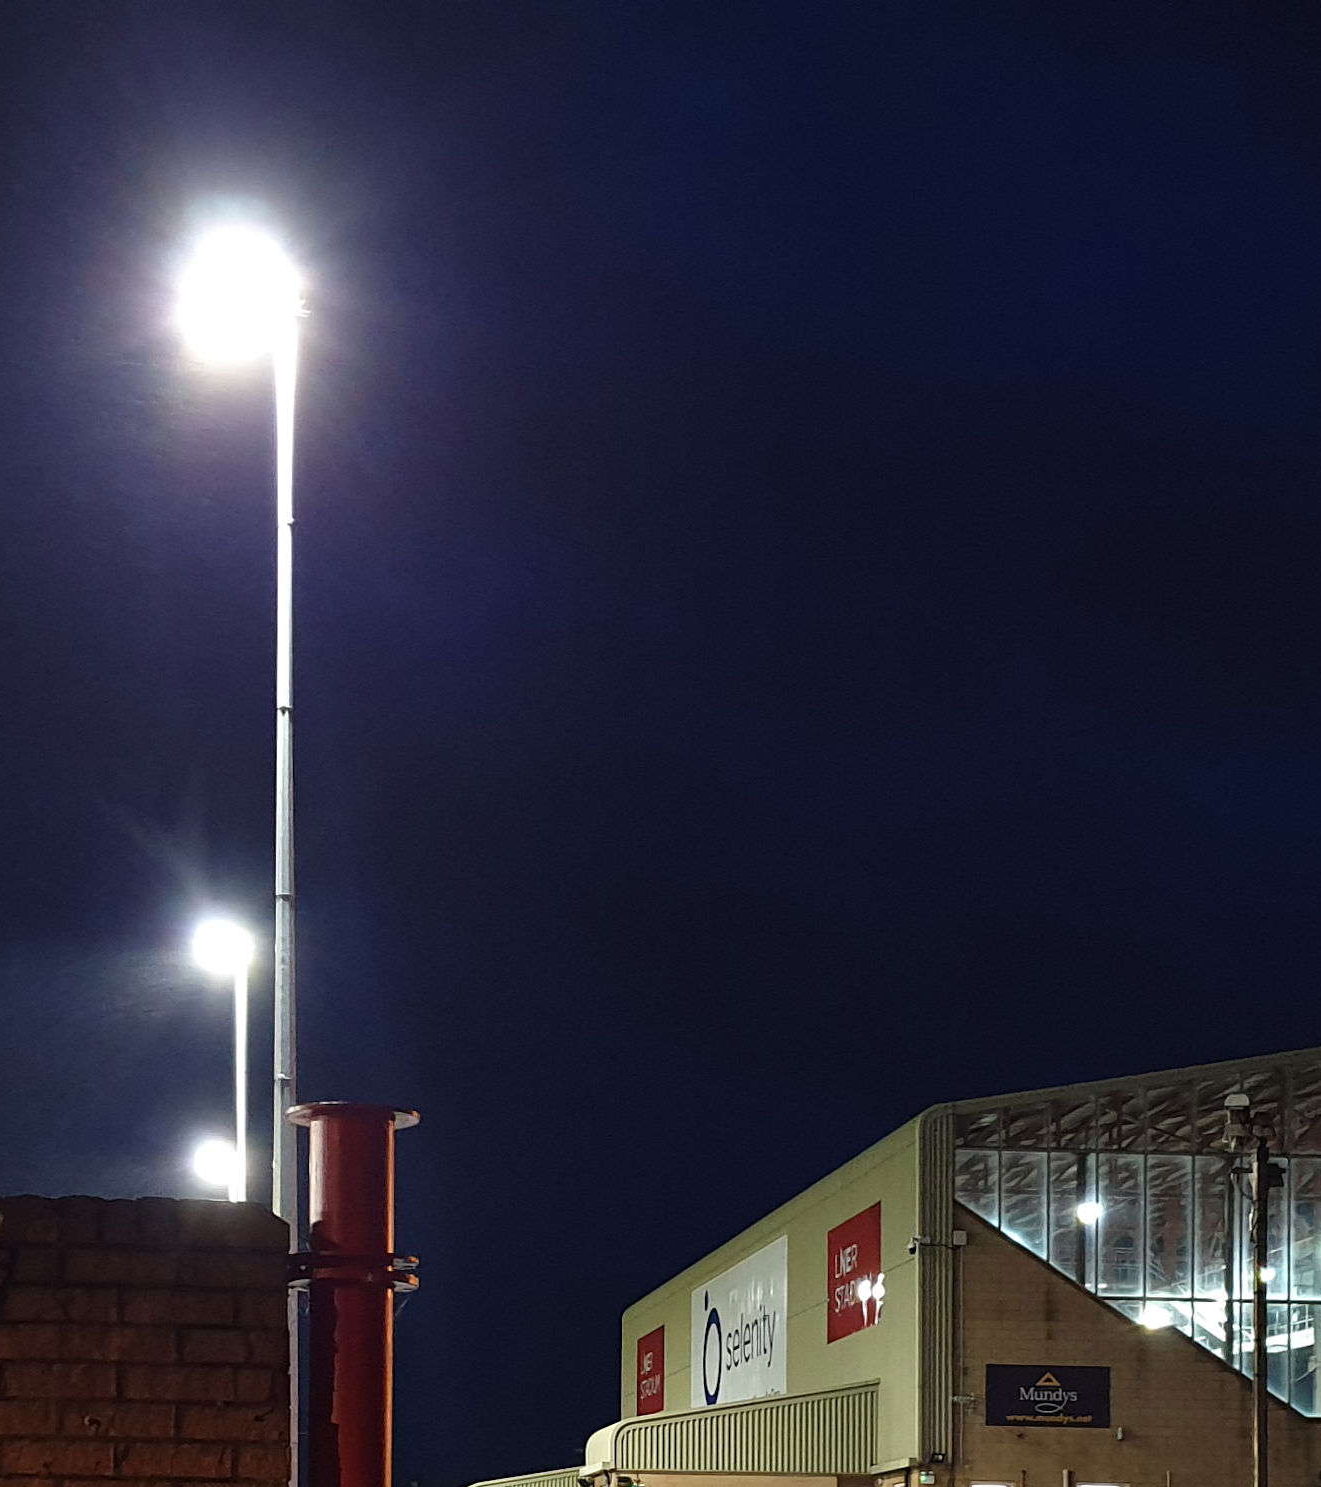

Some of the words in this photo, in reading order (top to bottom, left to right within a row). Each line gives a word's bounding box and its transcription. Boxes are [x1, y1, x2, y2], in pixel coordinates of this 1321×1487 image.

[834, 1243, 858, 1279] LNER
[725, 1305, 776, 1371] selenity
[1019, 1386, 1078, 1410] Mundys
